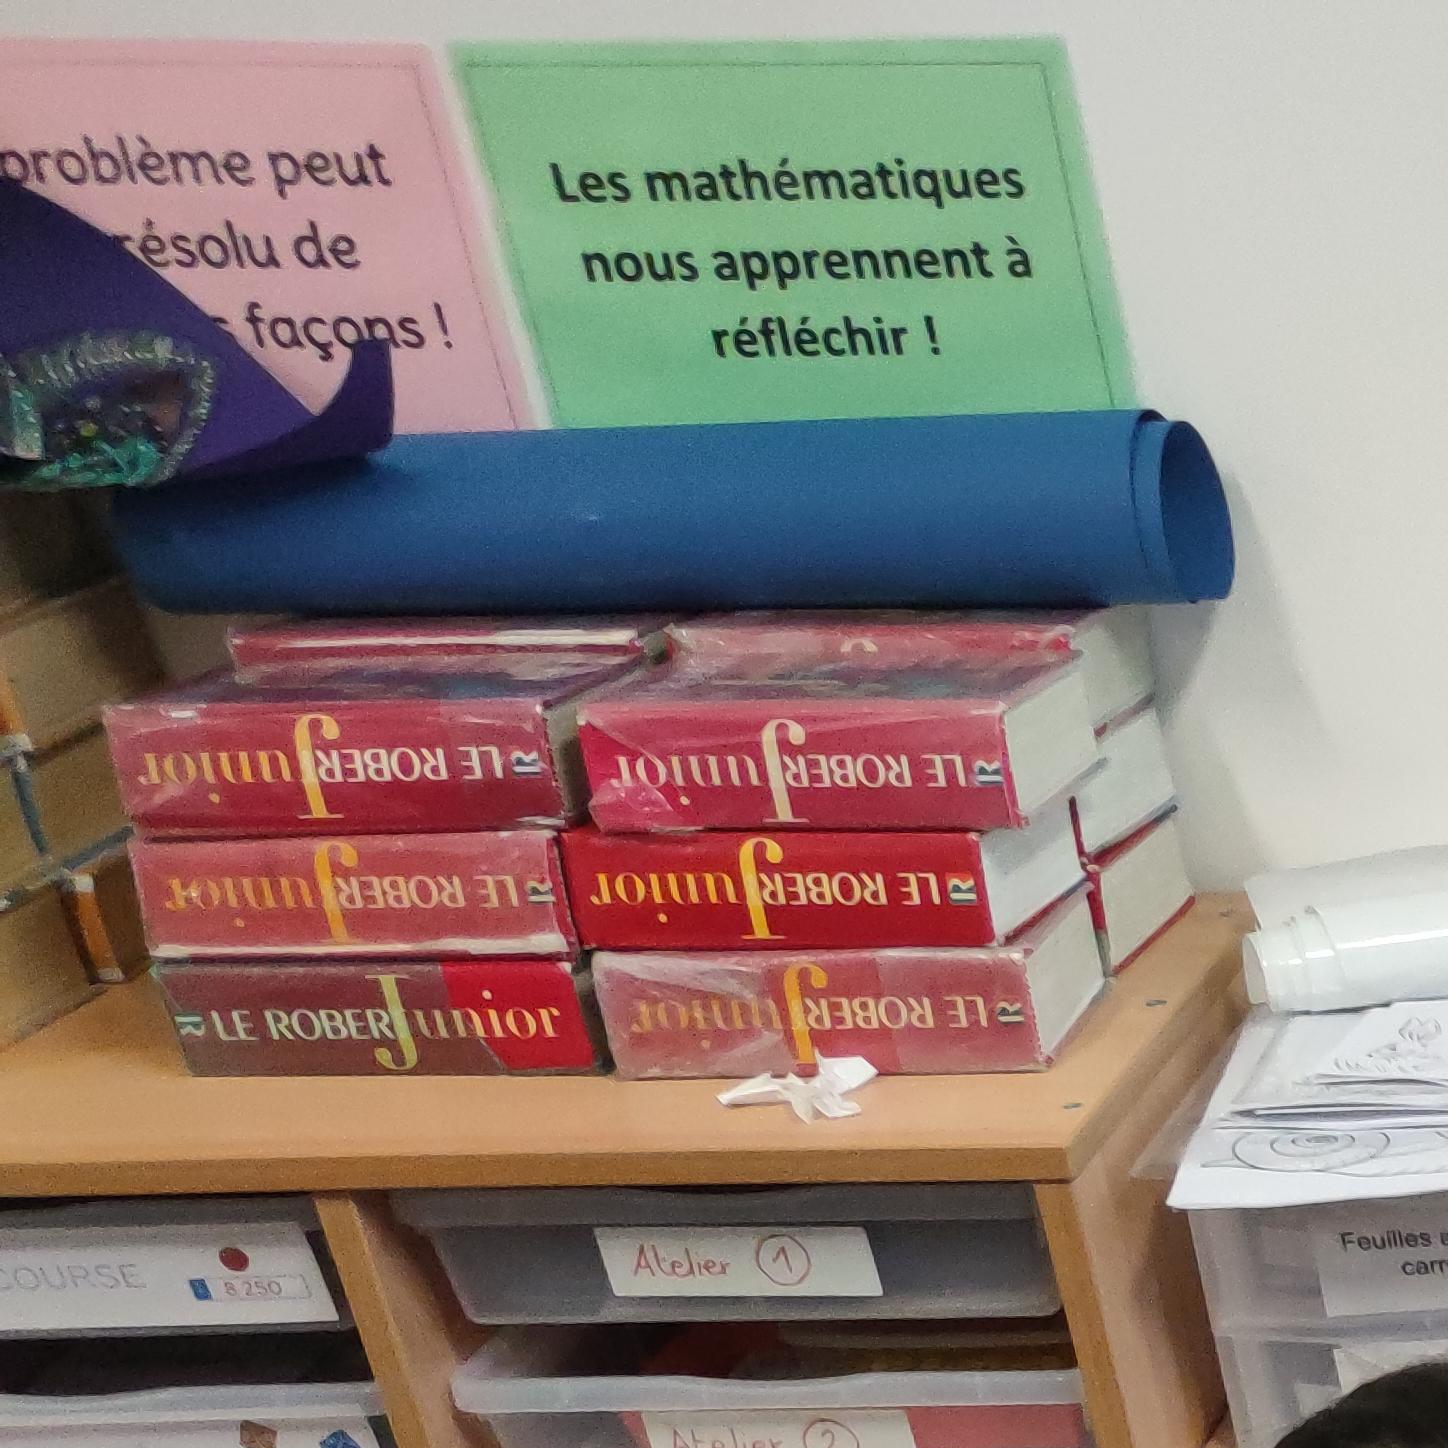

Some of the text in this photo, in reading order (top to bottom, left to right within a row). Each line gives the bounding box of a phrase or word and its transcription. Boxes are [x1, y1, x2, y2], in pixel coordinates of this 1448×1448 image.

[267, 142, 393, 199] peut
[549, 157, 1025, 210] Les mathématiques
[293, 220, 361, 269] de
[581, 235, 1033, 291] nous apprennent à
[245, 301, 426, 362] façons
[710, 314, 909, 359] réfléchir
[138, 713, 343, 819] Junior
[462, 745, 504, 779] LE
[610, 719, 809, 823] Junior
[925, 754, 973, 787] LE
[475, 873, 520, 908] LE
[590, 837, 788, 940] Junior
[899, 871, 939, 906] LE
[210, 1007, 258, 1042] LE
[365, 974, 561, 1071] Junior
[948, 994, 990, 1028] LE
[632, 1243, 730, 1281] Atelier
[1339, 1229, 1433, 1254] Feuilles
